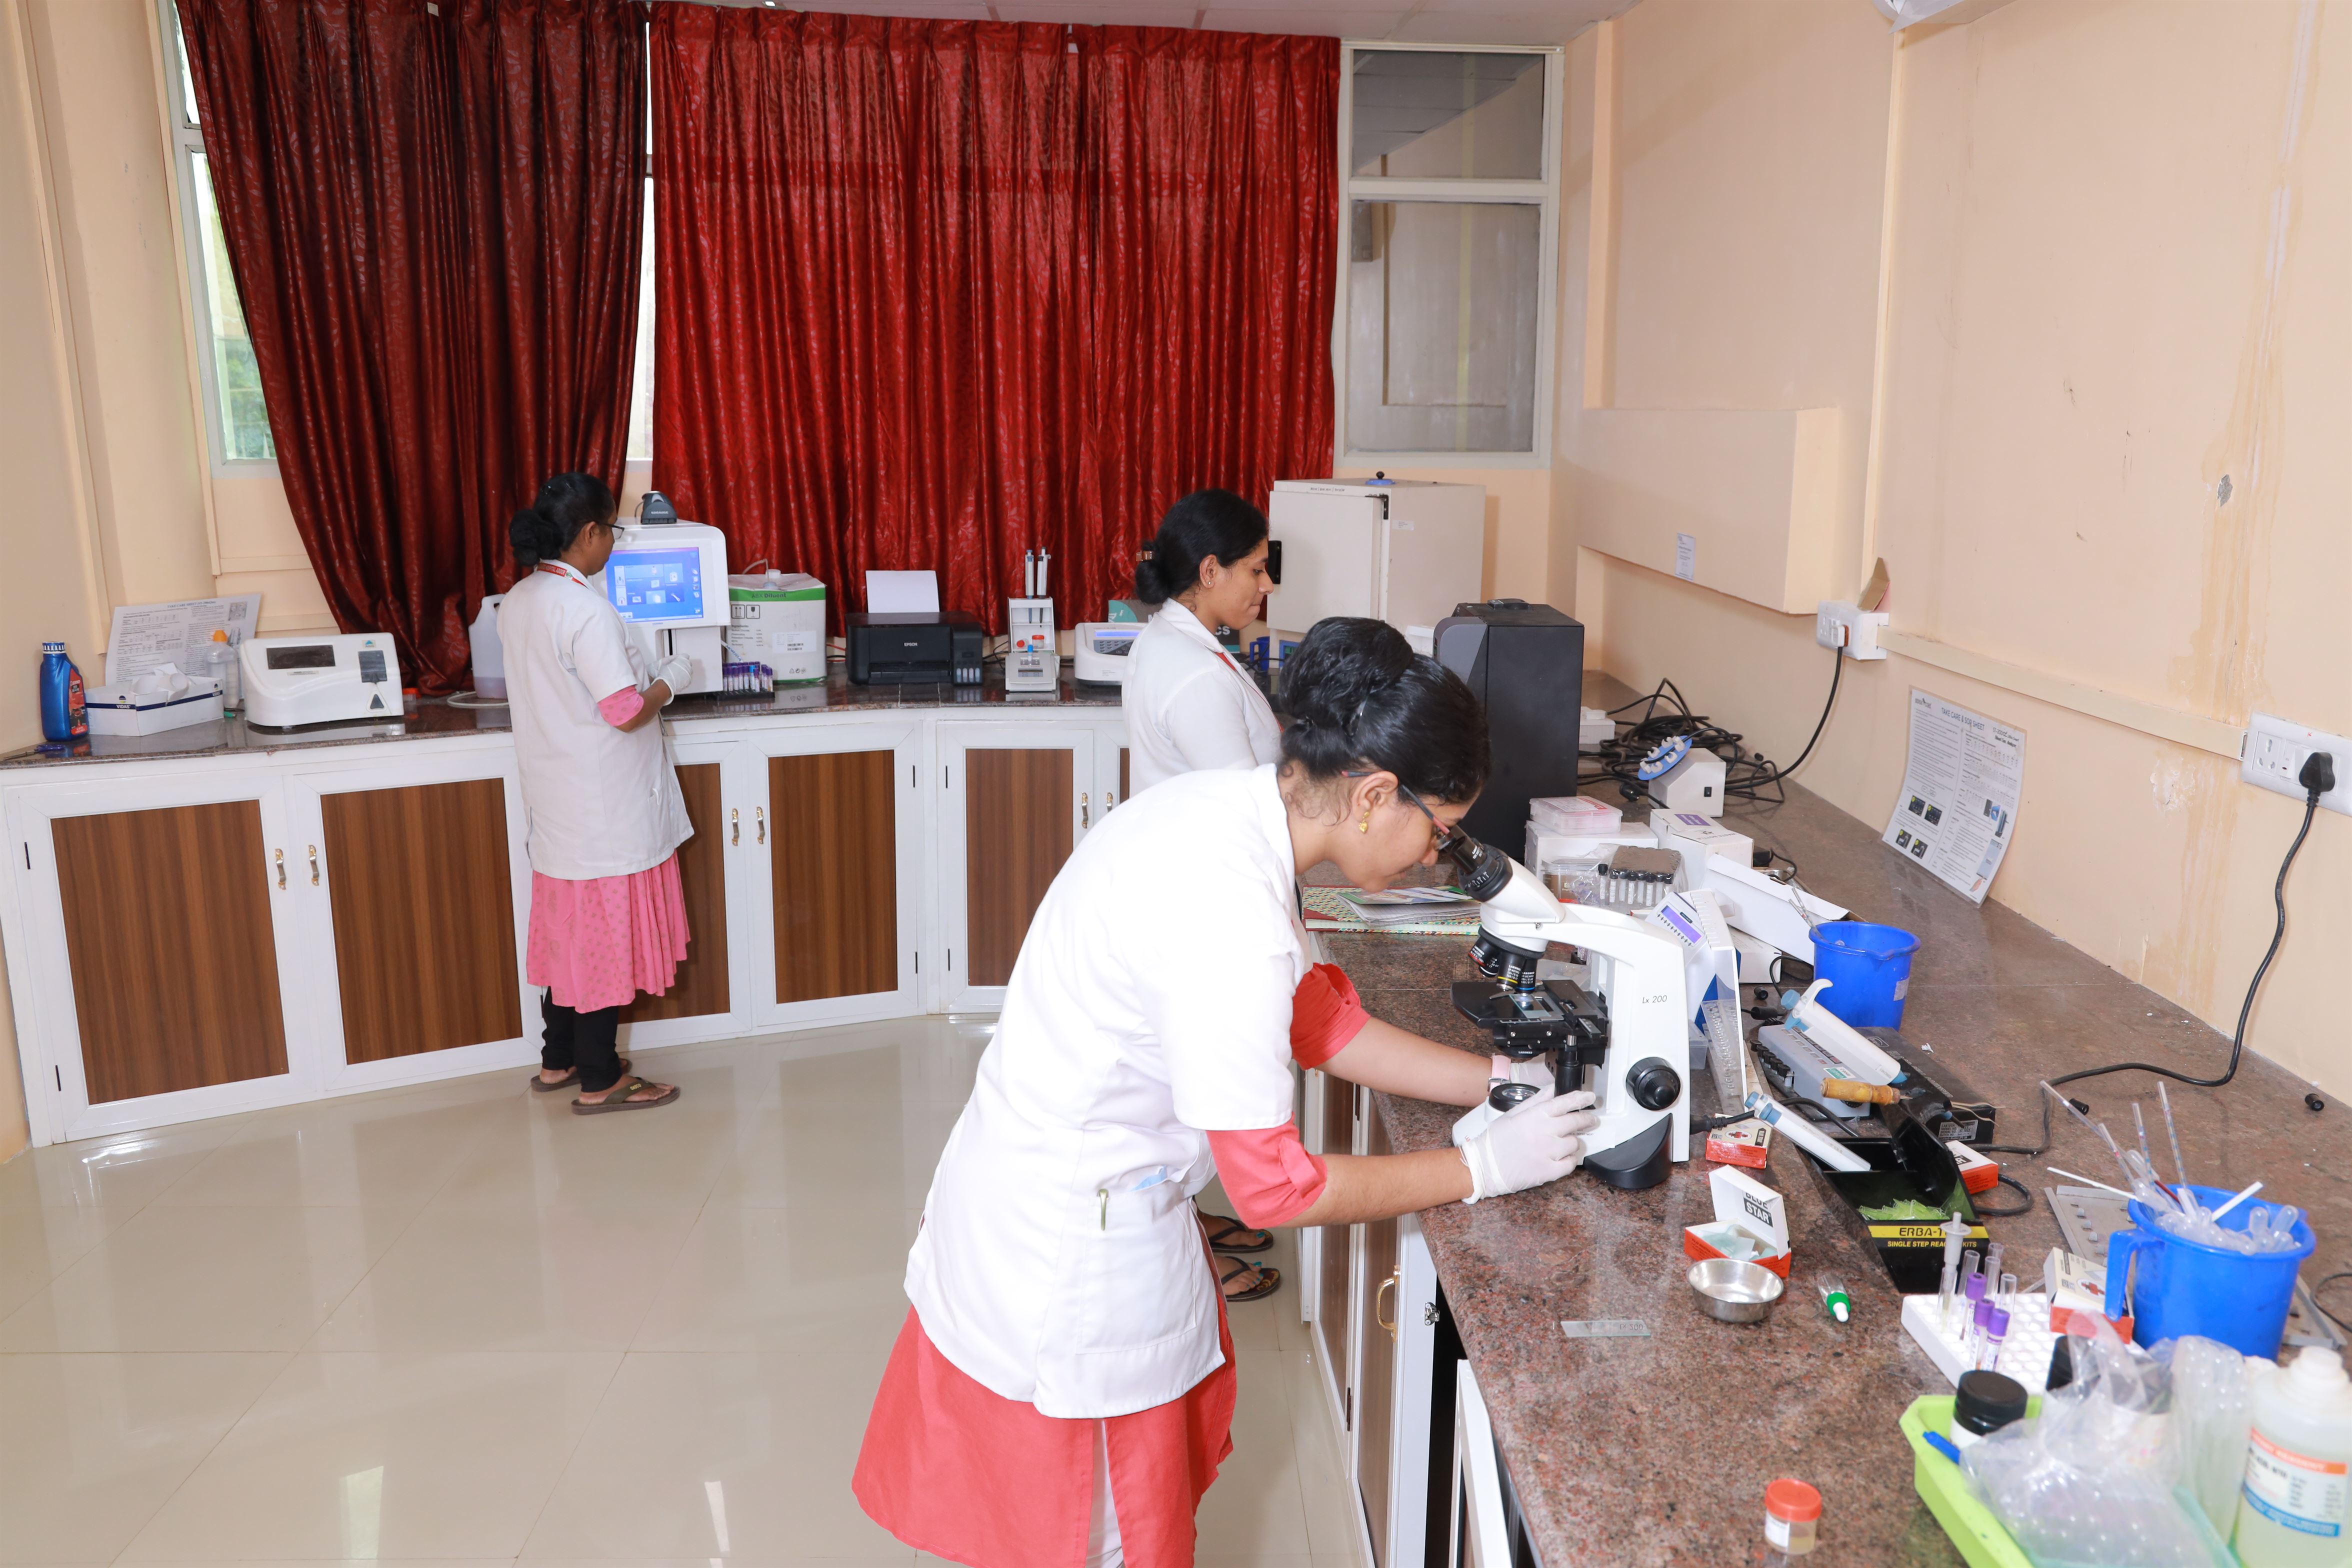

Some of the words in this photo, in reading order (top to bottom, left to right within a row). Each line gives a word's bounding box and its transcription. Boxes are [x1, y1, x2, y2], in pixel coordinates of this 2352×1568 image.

[1942, 708, 1950, 717] TAKE
[1951, 712, 1960, 721] CARE
[1972, 720, 1985, 730] SHEET
[1747, 1202, 1770, 1225] STAR
